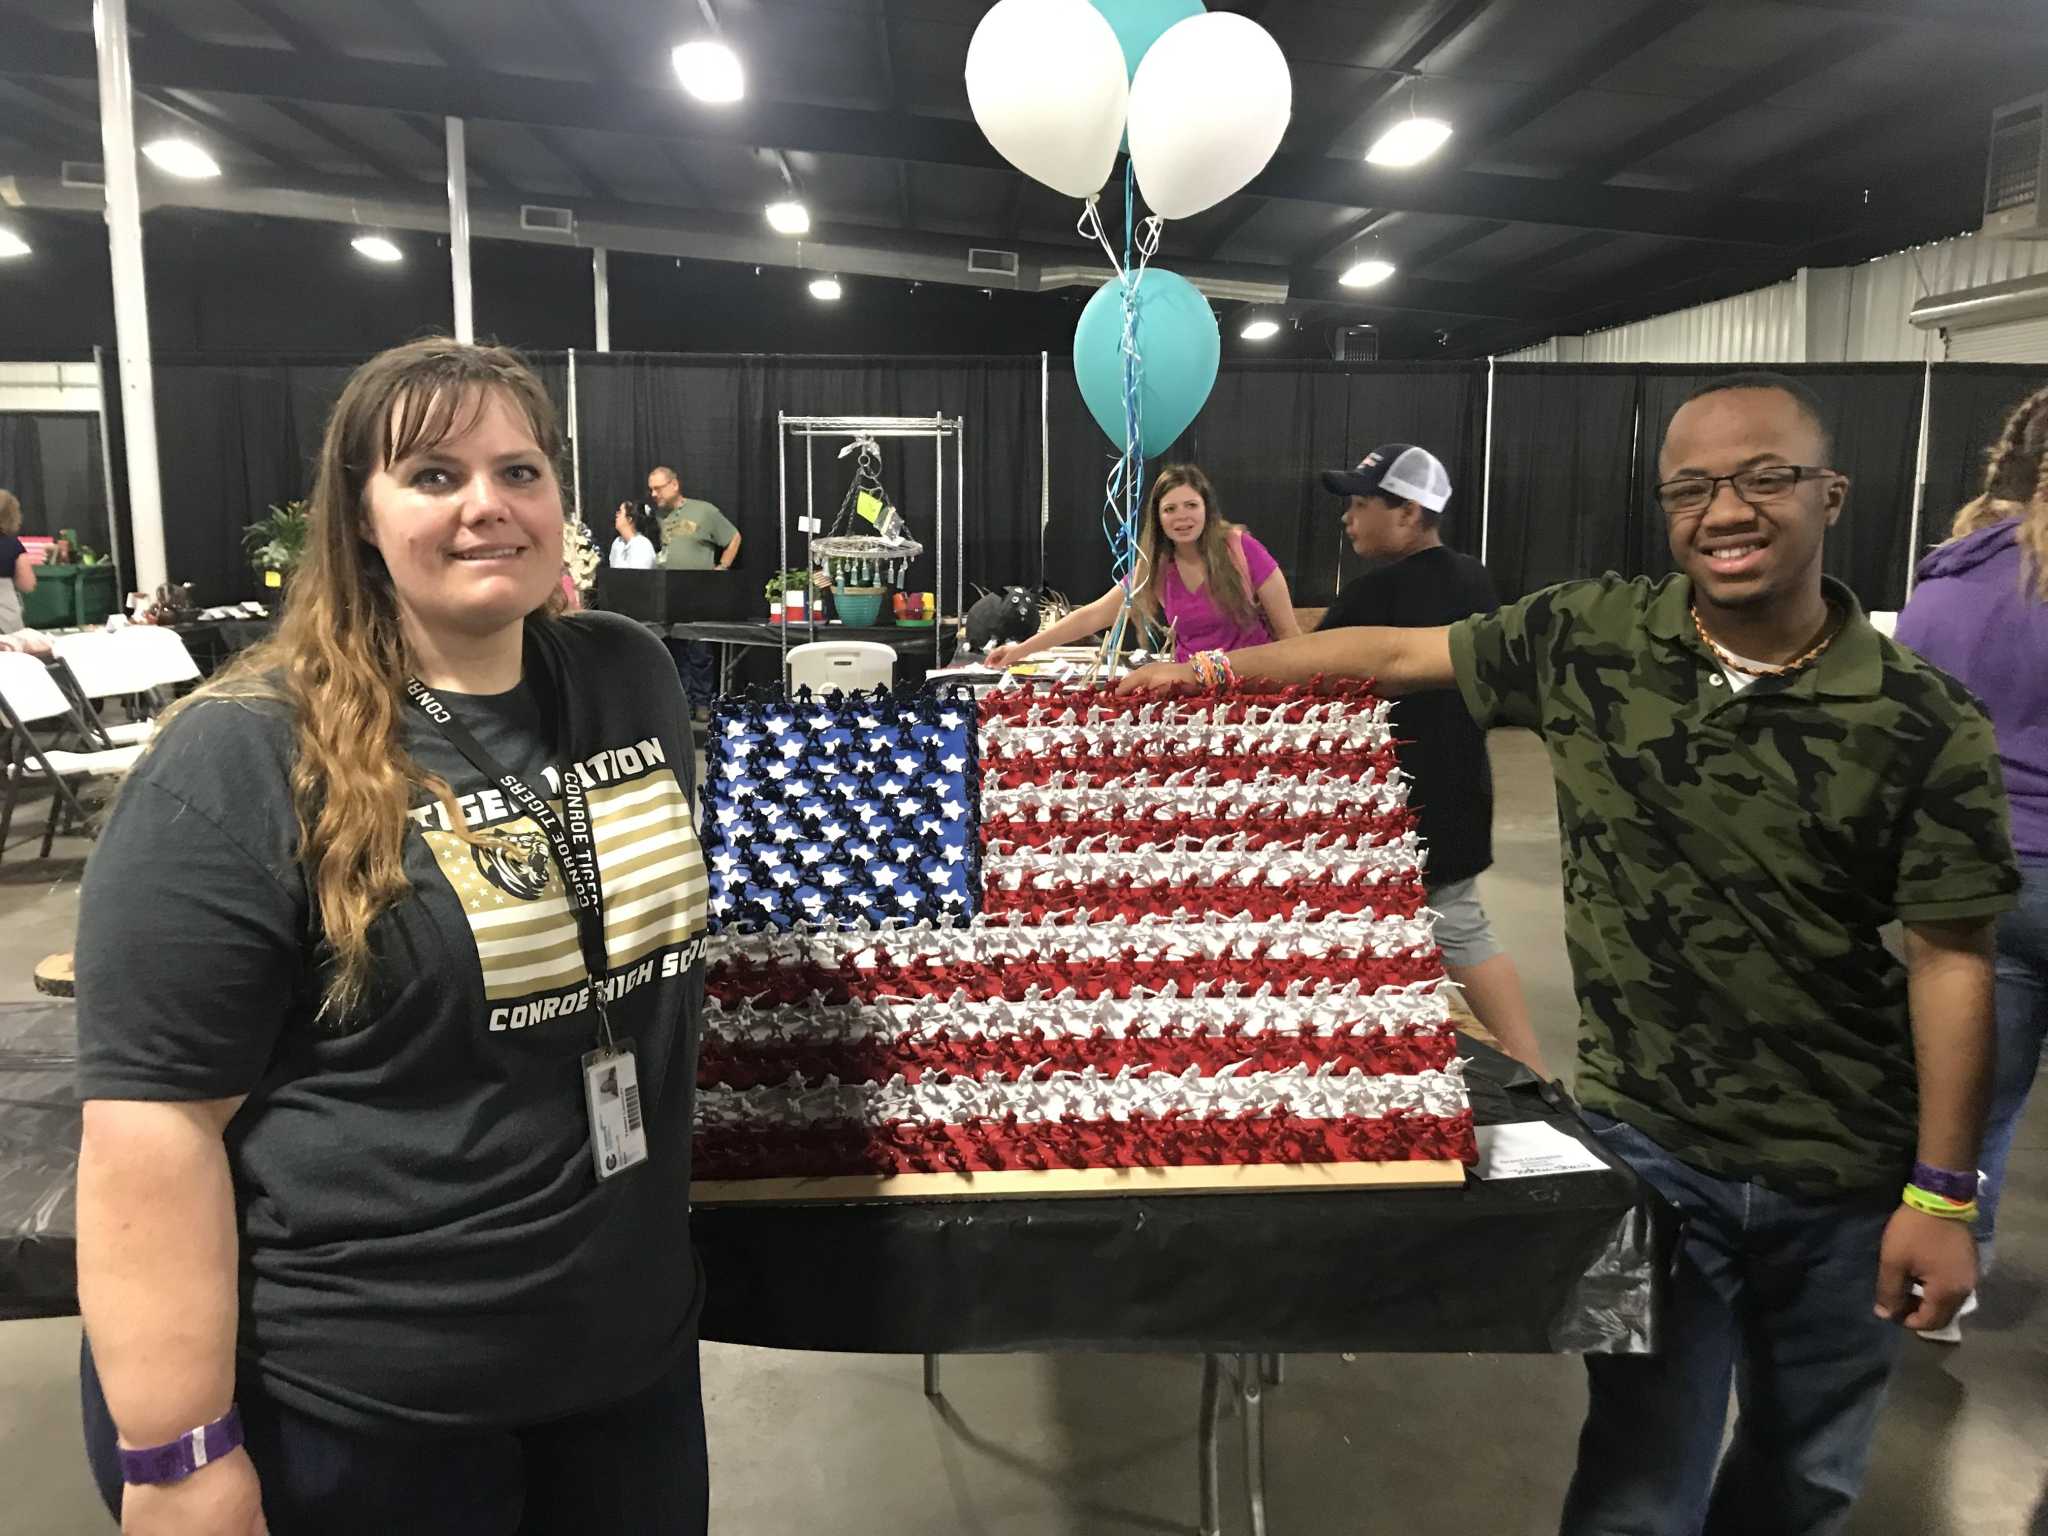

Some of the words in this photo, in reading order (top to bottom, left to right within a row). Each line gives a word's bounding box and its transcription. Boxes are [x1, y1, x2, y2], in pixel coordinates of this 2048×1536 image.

[406, 788, 522, 831] TIGE
[500, 775, 557, 829] TIGERS
[564, 772, 590, 845] CONROE
[551, 831, 590, 908] CONROE
[488, 986, 589, 1032] CONROE
[595, 959, 654, 1002] HIGH
